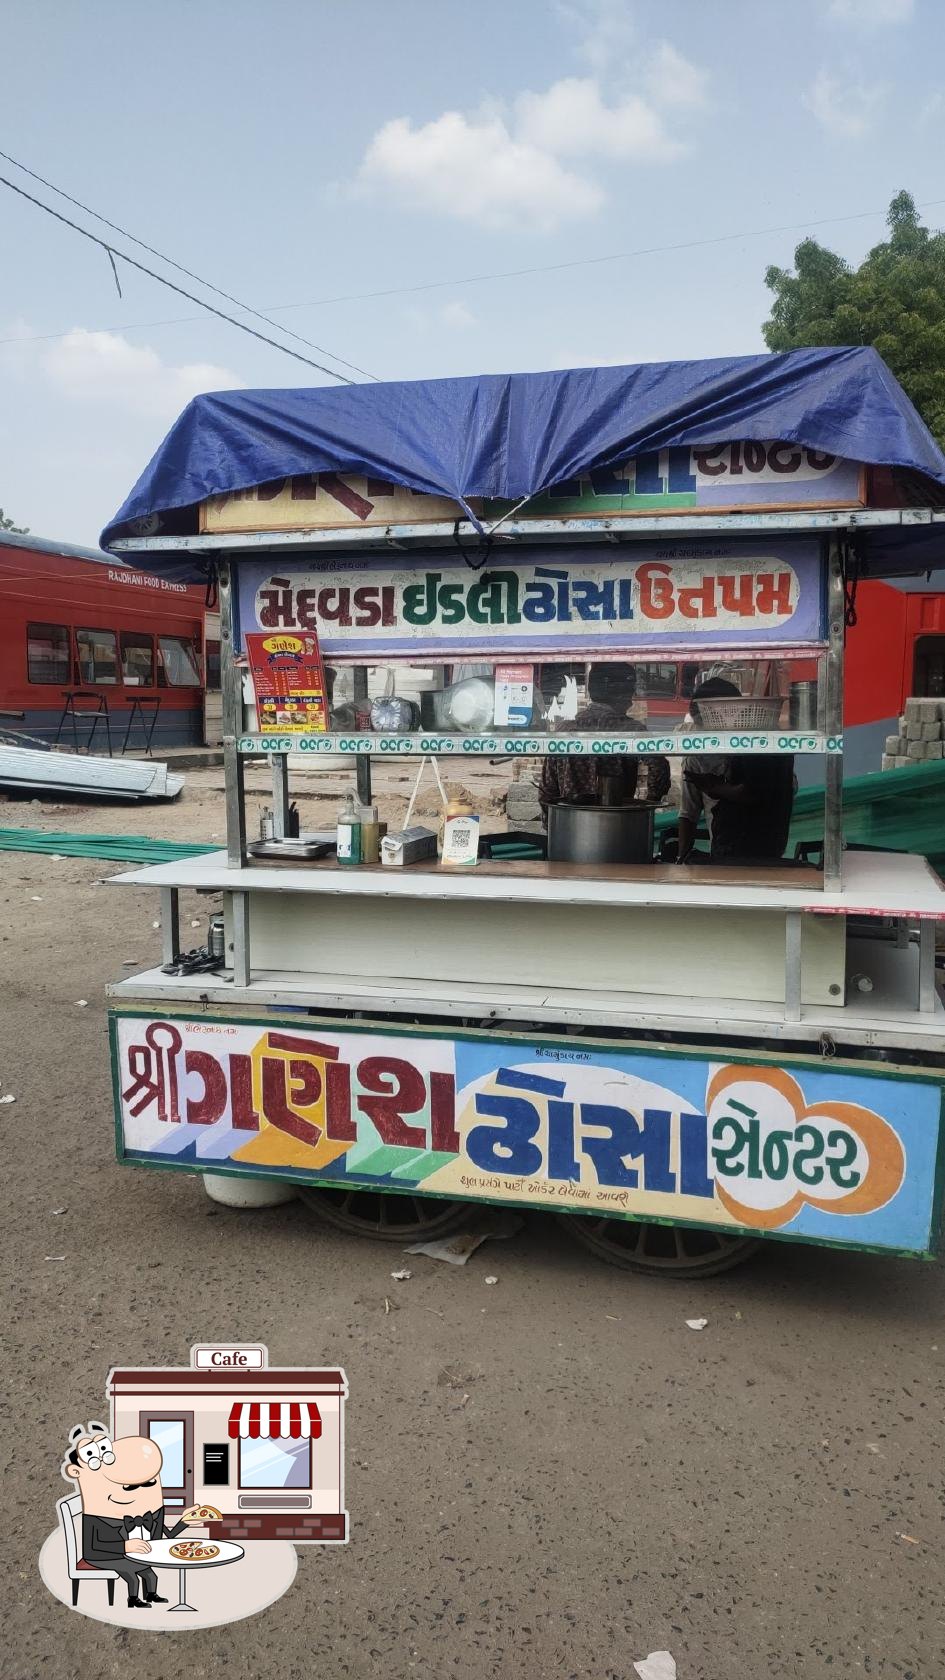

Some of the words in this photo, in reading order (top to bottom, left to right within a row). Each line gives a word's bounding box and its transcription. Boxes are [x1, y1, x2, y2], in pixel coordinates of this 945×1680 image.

[108, 570, 143, 585] RAJDHANI
[144, 576, 159, 588] FOOD
[160, 580, 187, 592] EXPRESS
[522, 566, 634, 622] ઢોસા
[634, 562, 793, 620] ઉતપમ
[122, 1021, 181, 1123] શ્રી
[184, 1031, 460, 1154] ગણેશ
[465, 1066, 716, 1199] ઢોસા
[711, 1098, 861, 1189] સેન્ટર
